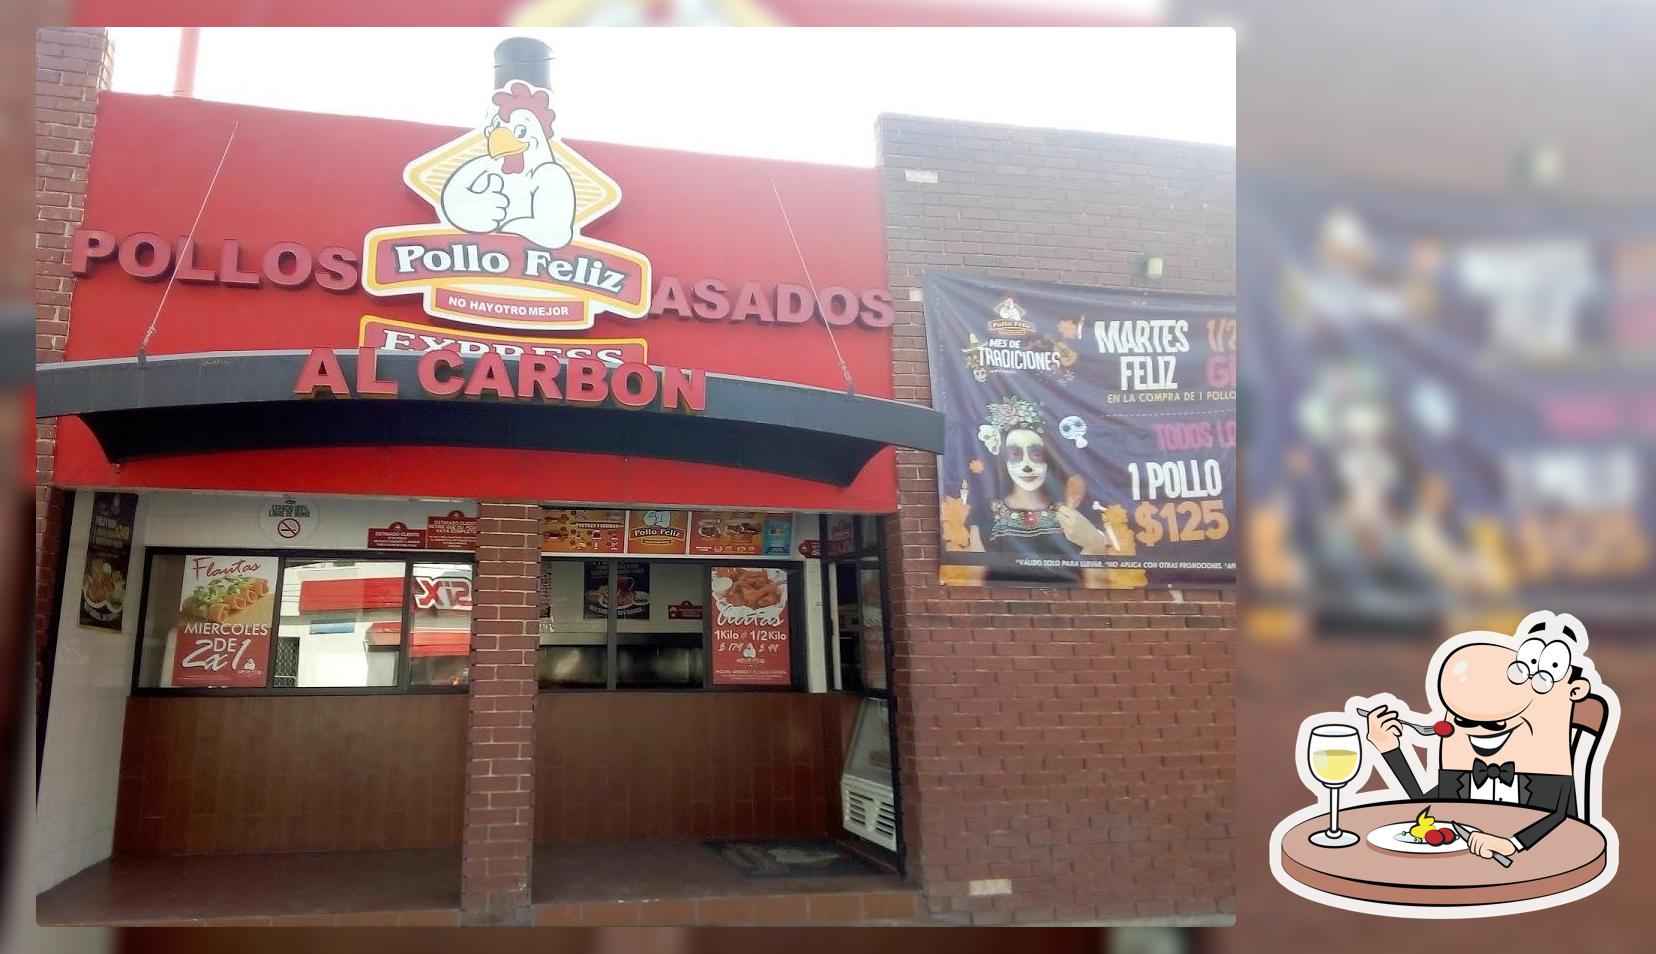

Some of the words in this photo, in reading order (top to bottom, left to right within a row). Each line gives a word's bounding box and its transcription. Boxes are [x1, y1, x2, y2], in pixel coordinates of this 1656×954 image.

[71, 230, 358, 292] POLLOS
[395, 244, 509, 273] Pollo
[525, 249, 625, 293] Feliz
[448, 297, 467, 308] NO
[470, 299, 495, 313] HAY
[528, 306, 569, 316] MEJOR
[650, 276, 895, 327] ASADOS
[989, 338, 1008, 348] MES
[1009, 339, 1021, 349] DE
[1094, 319, 1190, 353] MARTES
[978, 345, 1061, 371] TRADICIONES
[1120, 355, 1178, 391] FELIZ
[294, 347, 398, 395] AL
[417, 349, 706, 411] CARBON
[1107, 393, 1121, 404] EN
[1123, 393, 1136, 403] LA
[1139, 392, 1181, 403] COMPRA
[1184, 391, 1196, 401] DE
[1206, 390, 1236, 401] POLLO
[1156, 421, 1213, 451] TODOS
[1127, 462, 1141, 501] 1
[1145, 458, 1222, 500] POLLO
[634, 528, 657, 537] Pollo
[660, 529, 681, 537] Feliz
[1135, 500, 1229, 547] $125
[192, 556, 261, 581] Flautas
[1159, 561, 1178, 569] OTRAS
[184, 622, 268, 636] MIERCOLES
[182, 638, 252, 671] 2x1
[213, 637, 237, 652] DE
